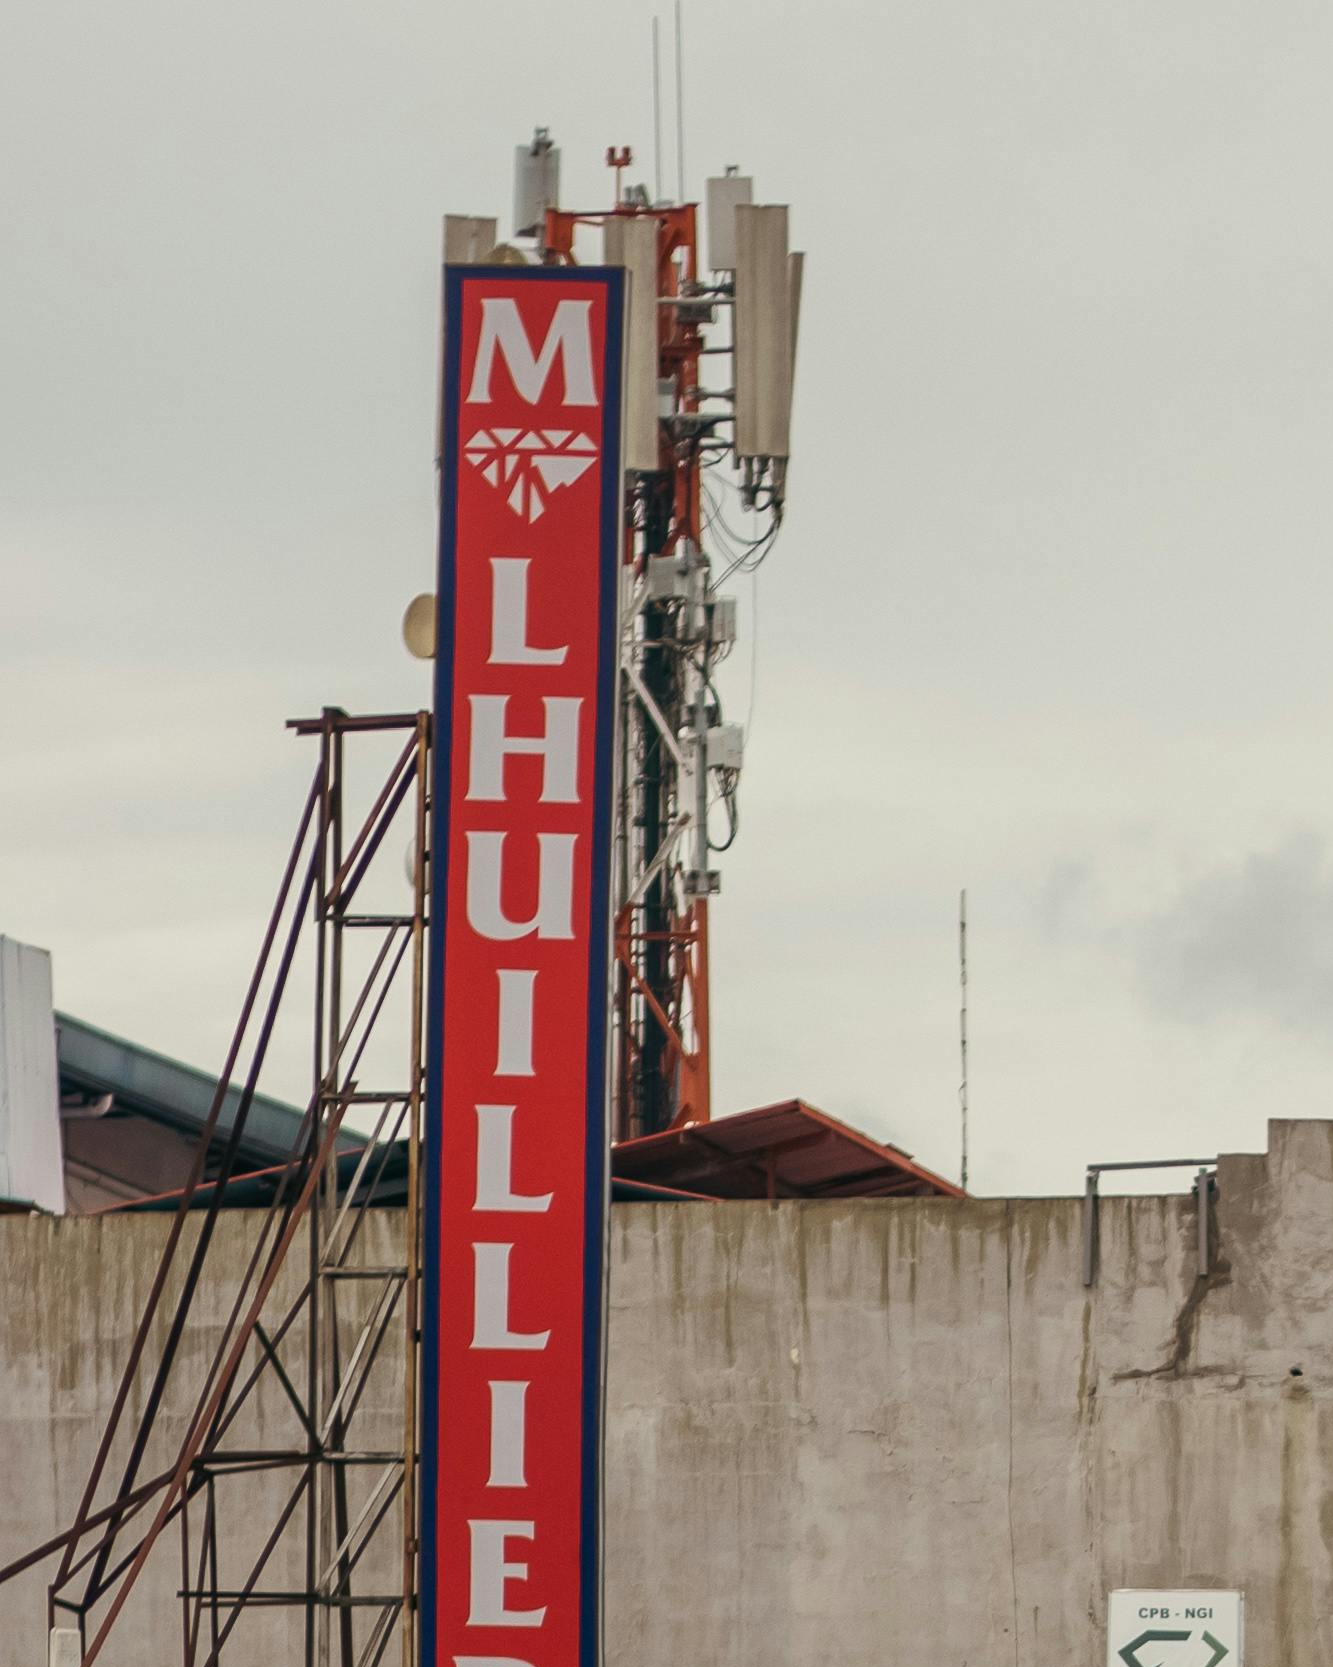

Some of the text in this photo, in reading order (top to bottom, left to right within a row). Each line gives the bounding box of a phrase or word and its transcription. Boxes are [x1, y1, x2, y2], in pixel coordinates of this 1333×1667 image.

[466, 298, 598, 406] M
[1138, 1608, 1213, 1618] CPB NGI
